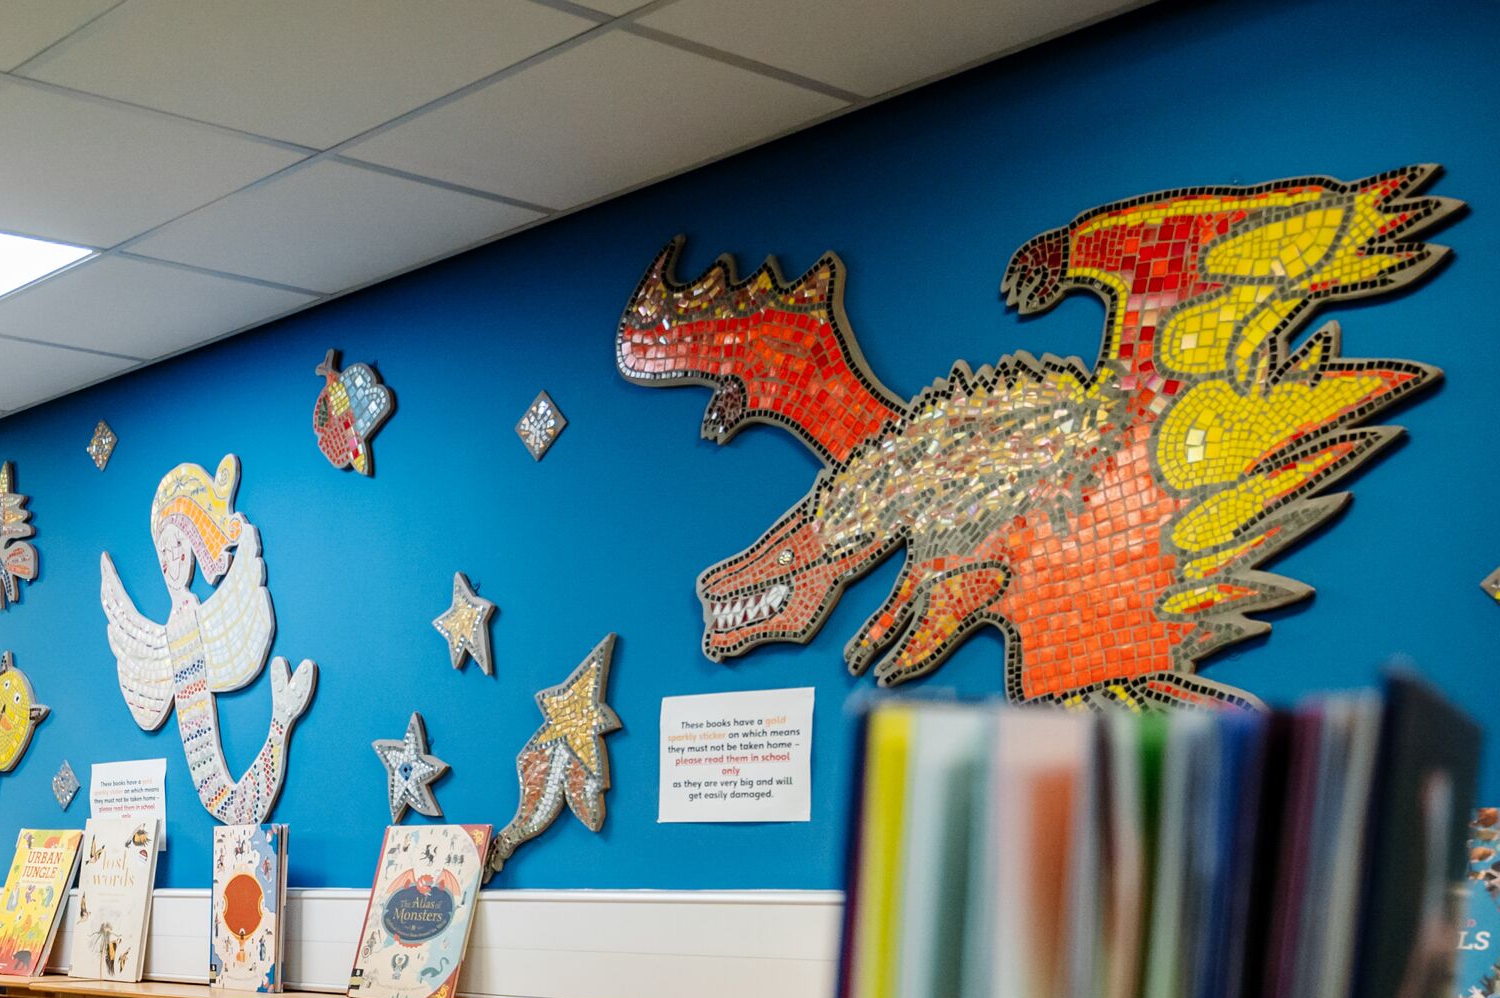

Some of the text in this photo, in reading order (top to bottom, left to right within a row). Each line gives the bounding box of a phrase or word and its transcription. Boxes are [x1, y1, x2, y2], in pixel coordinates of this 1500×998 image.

[681, 721, 703, 729] These
[706, 719, 731, 727] books
[765, 716, 786, 727] gold
[668, 733, 696, 743] sparkly
[700, 731, 725, 740] sticker
[742, 729, 767, 738] which
[668, 745, 684, 754] they
[675, 756, 702, 766] please
[761, 753, 790, 761] school
[722, 766, 740, 776] only
[684, 780, 701, 789] they
[720, 780, 737, 788] very
[740, 779, 753, 788] big
[756, 778, 773, 786] and
[776, 777, 792, 785] will
[689, 790, 774, 801] get easily damaged.
[28, 851, 63, 864] URBAN
[103, 850, 127, 870] lost
[22, 866, 57, 878] JUNGLE
[93, 867, 134, 887] words
[412, 896, 435, 909] Atlas
[393, 908, 443, 924] Monsters
